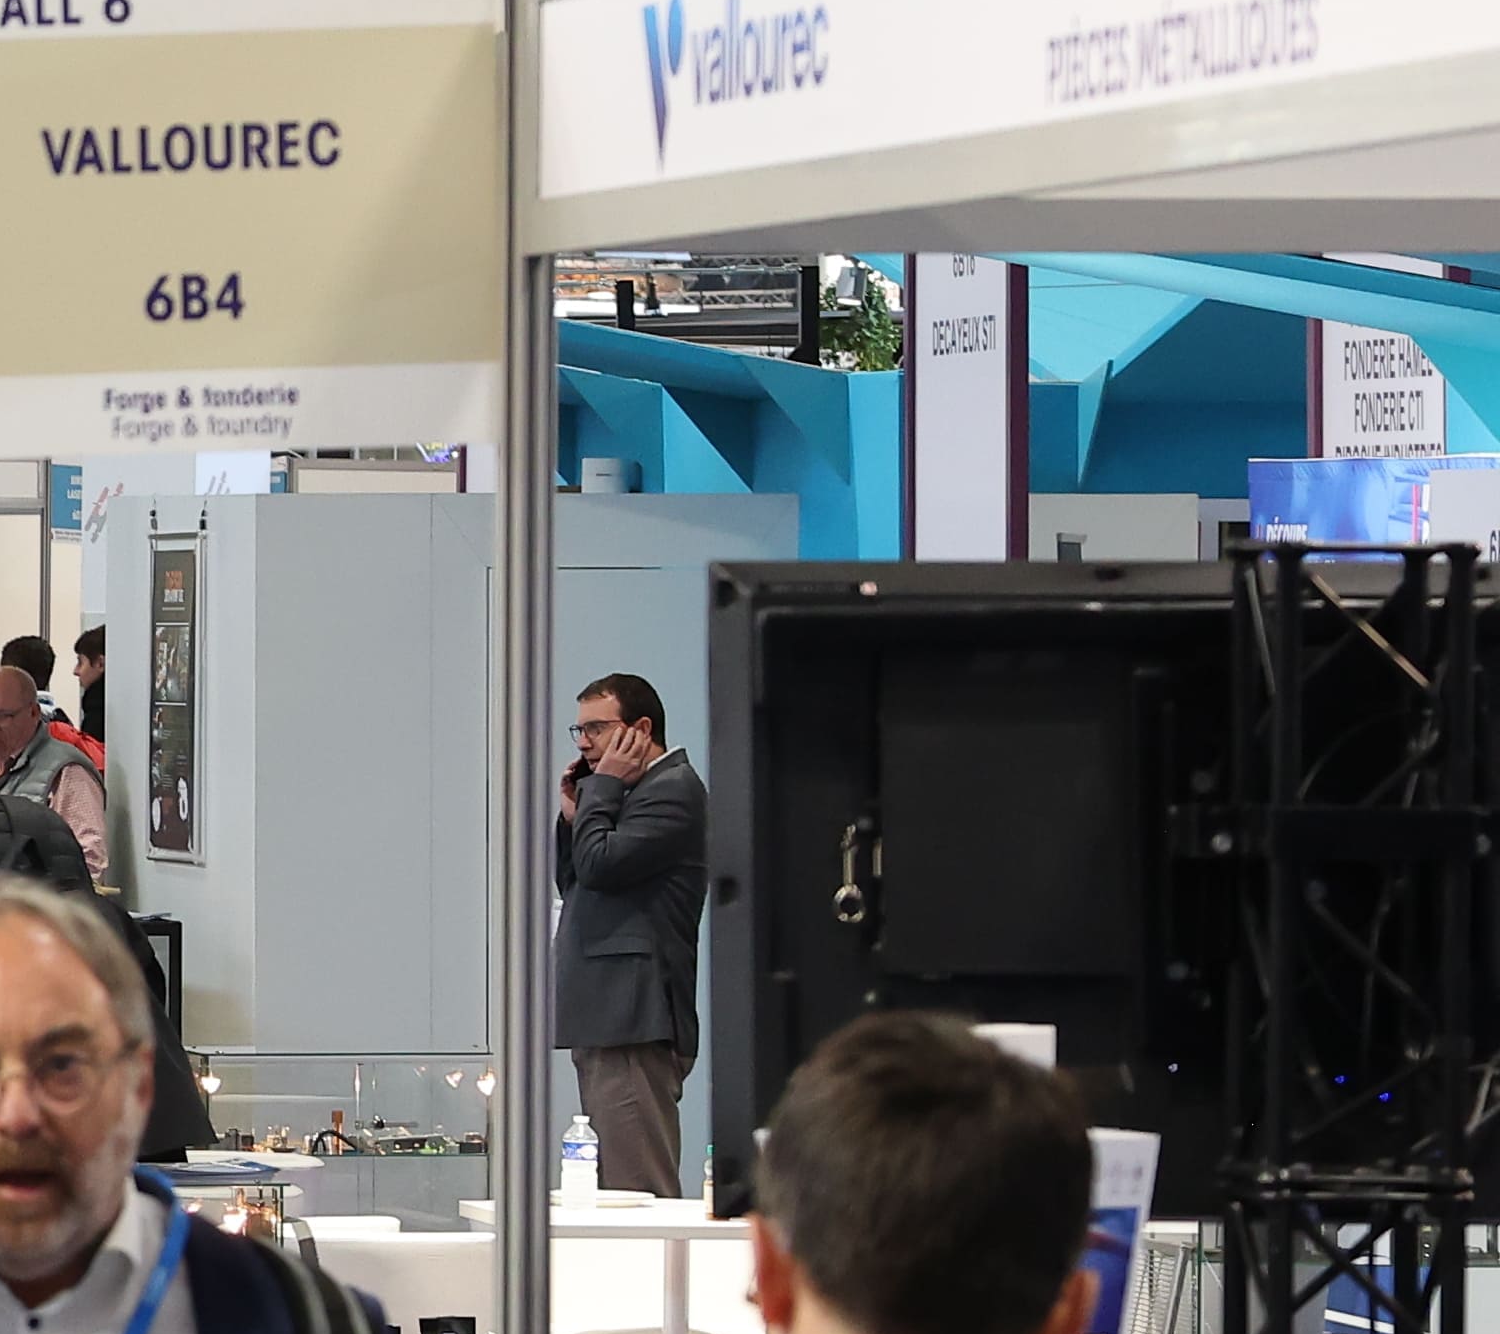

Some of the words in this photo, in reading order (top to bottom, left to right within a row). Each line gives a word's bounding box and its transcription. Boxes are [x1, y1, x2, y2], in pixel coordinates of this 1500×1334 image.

[42, 119, 341, 175] VALLOUREC
[146, 273, 245, 321] 6B4
[933, 317, 980, 355] DECAYEUX
[1344, 339, 1395, 381] FONDERIE
[104, 388, 165, 413] Forge
[178, 389, 190, 407] &
[1354, 391, 1404, 433] FONDERIE
[112, 415, 172, 441] Forge
[182, 416, 197, 436] &
[207, 413, 292, 439] foundry
